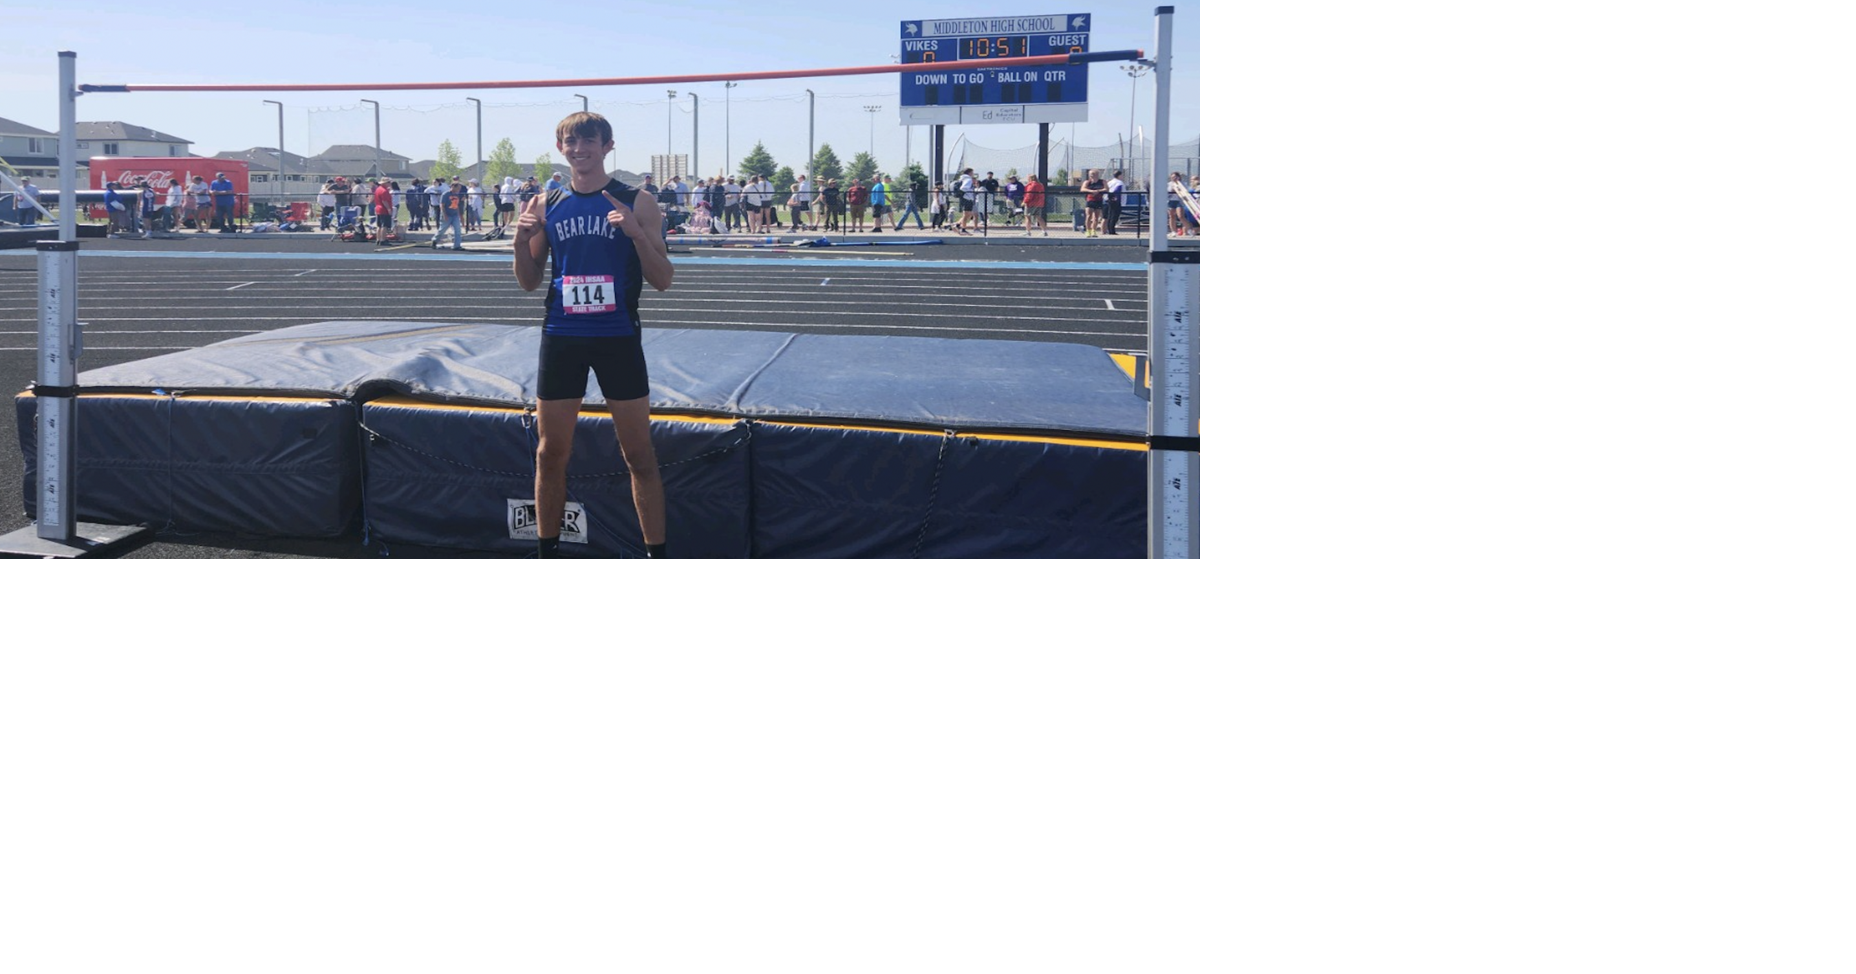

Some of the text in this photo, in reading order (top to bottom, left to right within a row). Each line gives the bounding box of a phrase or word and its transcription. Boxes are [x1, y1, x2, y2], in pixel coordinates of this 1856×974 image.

[933, 17, 1055, 35] MIDDLETON HIGH SCHOOL
[905, 40, 938, 51] VIKES
[969, 37, 1026, 57] 10:51
[1048, 34, 1087, 46] GUEST
[915, 72, 984, 85] DOWN TO GO
[998, 70, 1066, 83] BALL ON QTR
[982, 110, 993, 120] Ed
[118, 170, 174, 189] Coc-Cola
[555, 215, 616, 242] BEAR LAKE
[572, 285, 605, 306] 114
[514, 505, 580, 532] BLR
